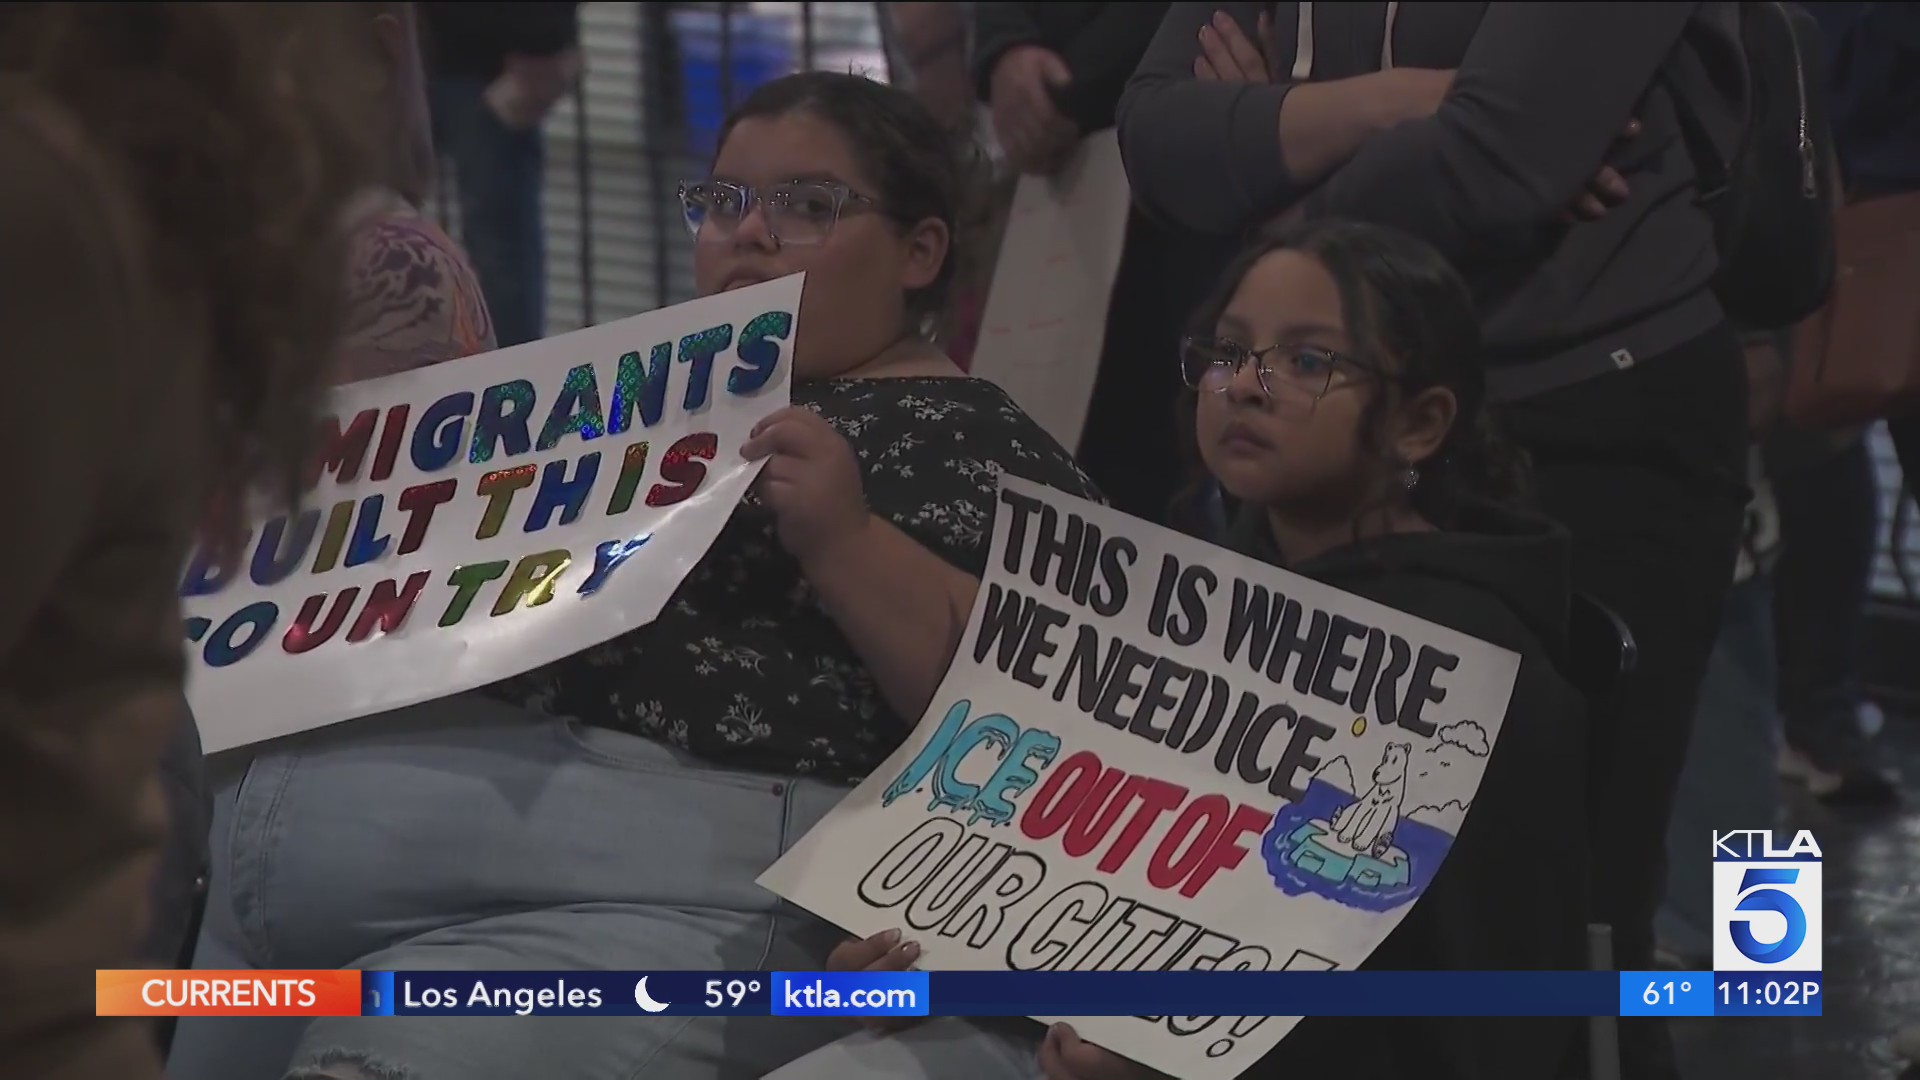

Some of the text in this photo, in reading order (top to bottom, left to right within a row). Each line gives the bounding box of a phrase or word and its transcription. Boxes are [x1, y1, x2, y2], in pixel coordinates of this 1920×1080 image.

[308, 311, 792, 486] MIGRANTS
[475, 433, 718, 540] THIS
[183, 533, 654, 667] OUNTRY
[1001, 489, 1460, 738] THIS IS WHERE
[973, 583, 1337, 803] WE NEED ICE
[859, 817, 1047, 949] OUR
[882, 699, 1273, 898] ICE OUT OF
